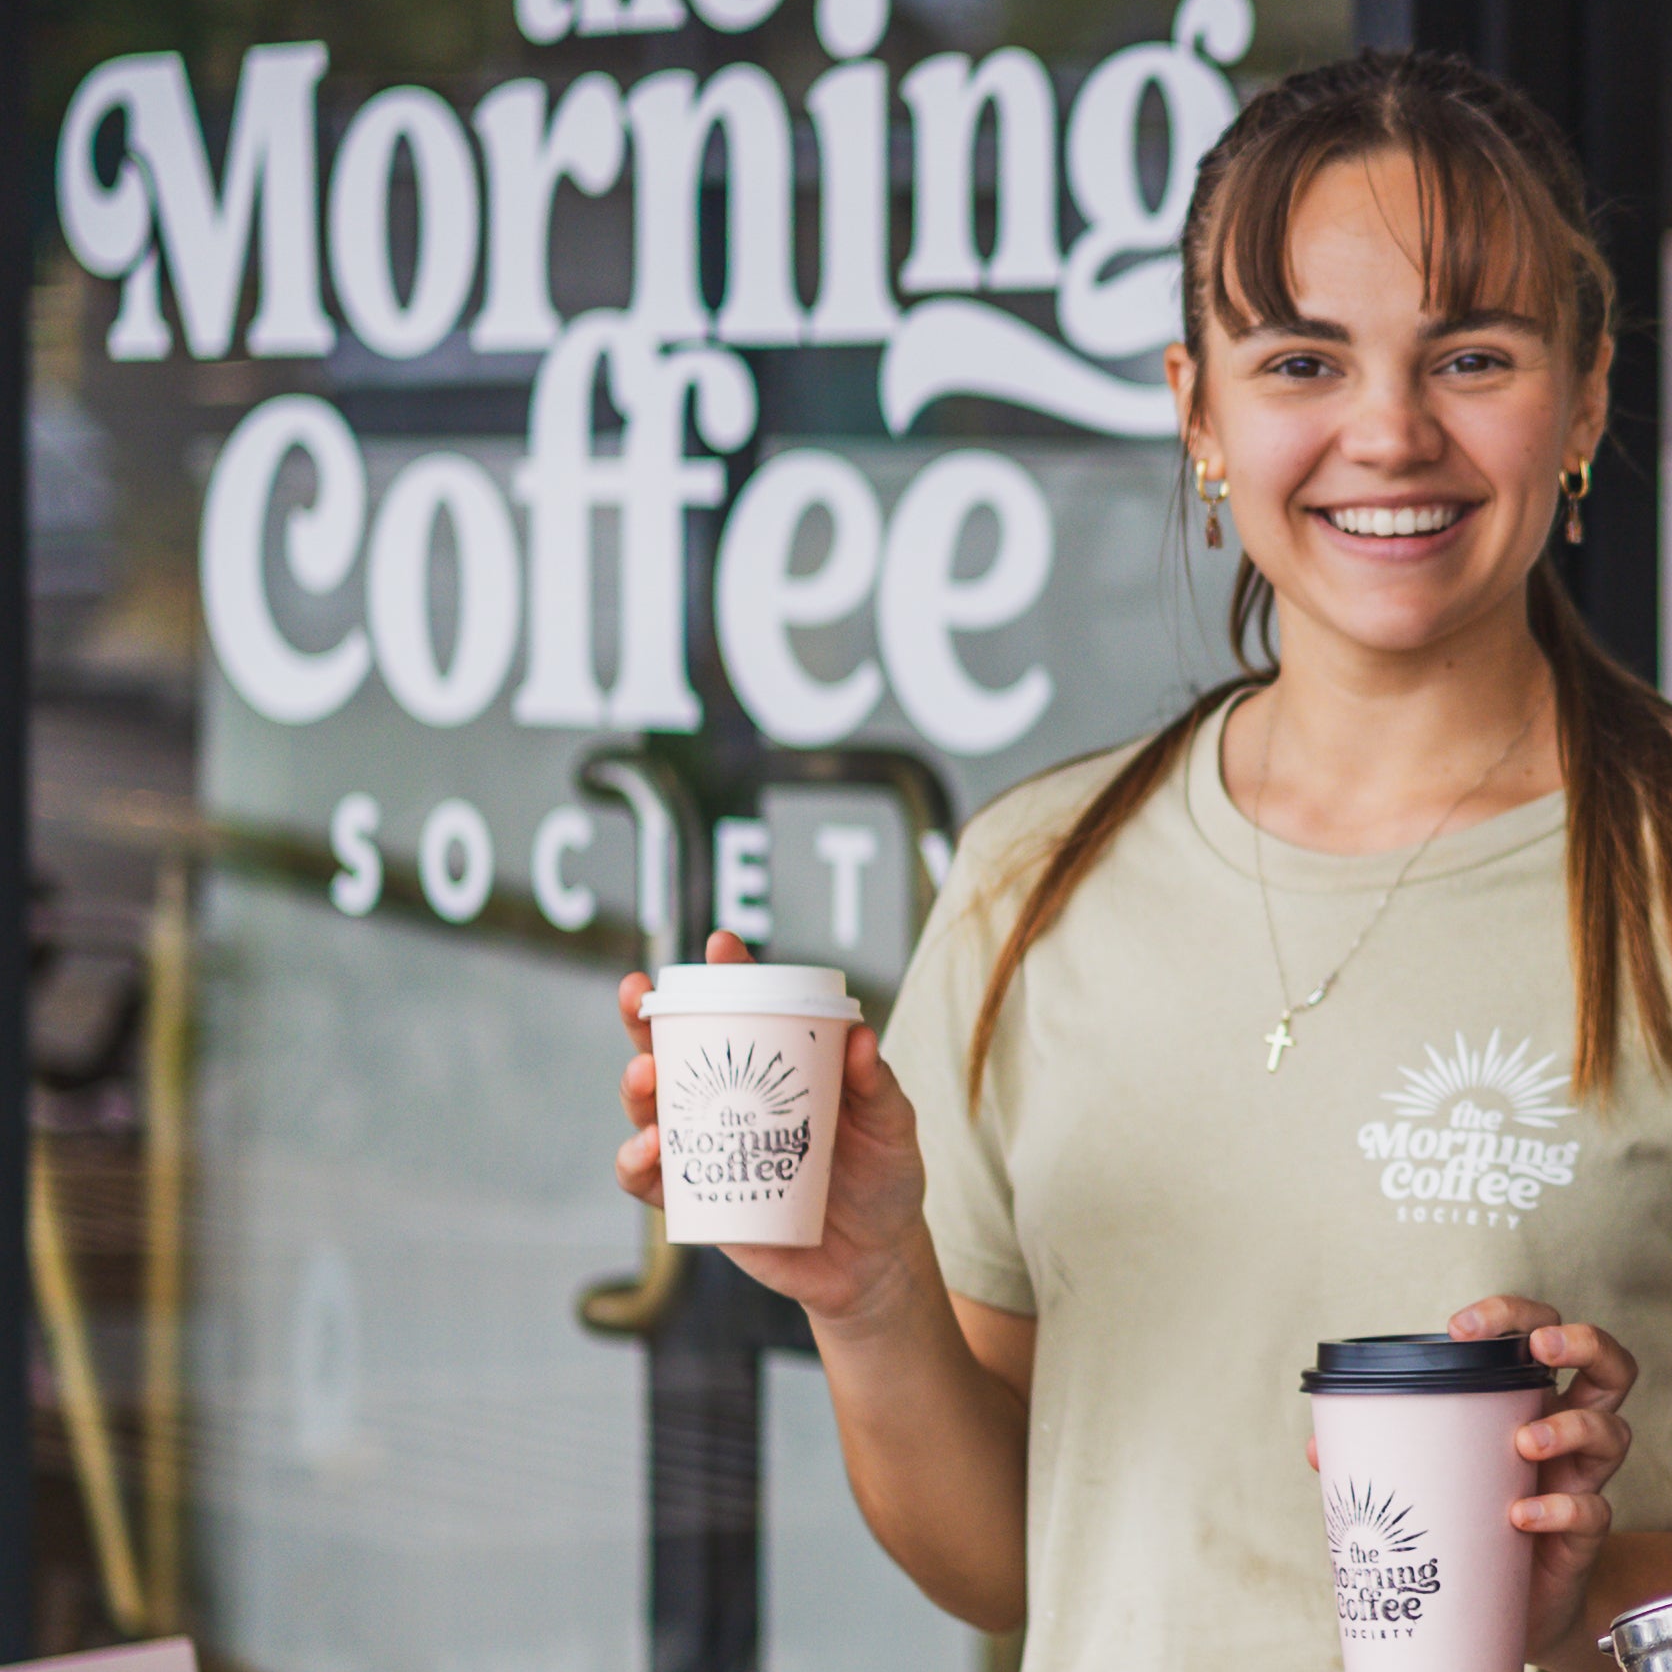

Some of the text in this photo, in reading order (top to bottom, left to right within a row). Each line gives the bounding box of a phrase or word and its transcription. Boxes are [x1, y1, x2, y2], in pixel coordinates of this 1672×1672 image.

[201, 308, 1053, 755] Coffee
[720, 1105, 757, 1127] the
[1449, 1098, 1505, 1131] the
[682, 1149, 794, 1185] Coffee
[1356, 1120, 1581, 1186] Morning
[1380, 1153, 1542, 1211] Coffee
[1396, 1205, 1521, 1230] SOCIETY
[1350, 1542, 1380, 1564] the
[1337, 1587, 1423, 1622] Coffee
